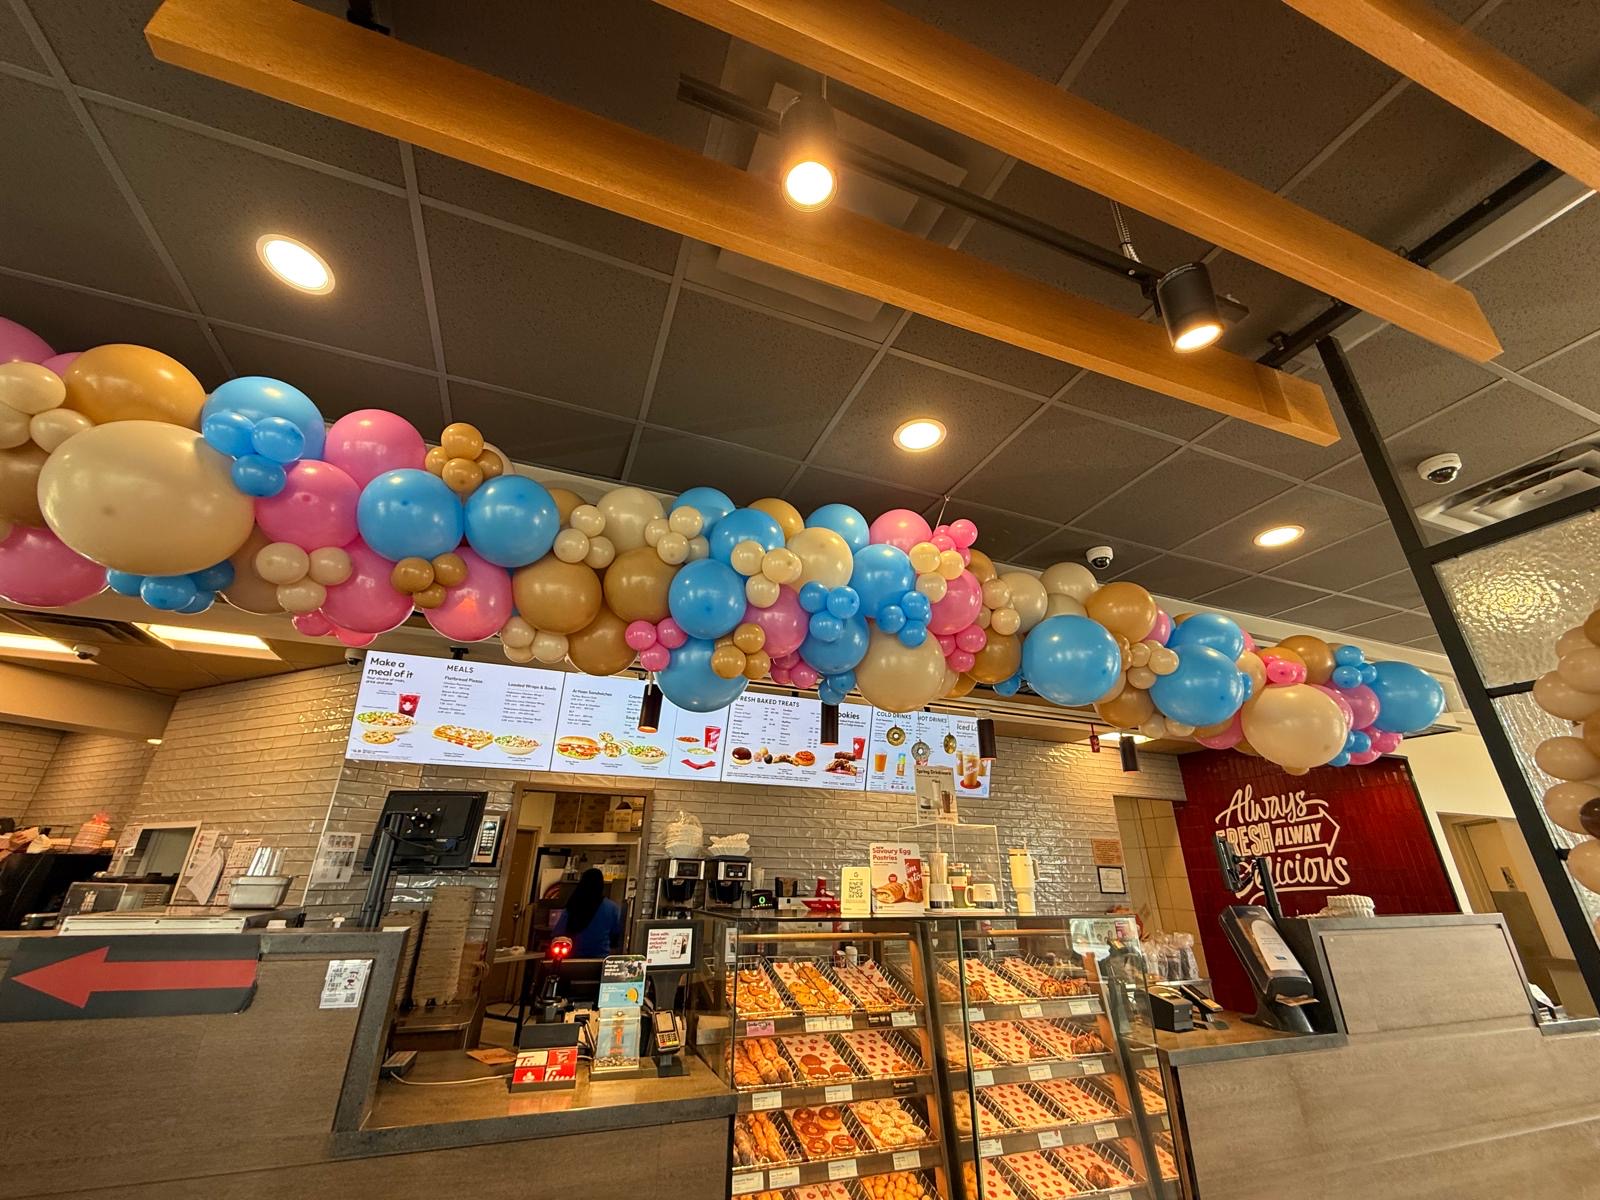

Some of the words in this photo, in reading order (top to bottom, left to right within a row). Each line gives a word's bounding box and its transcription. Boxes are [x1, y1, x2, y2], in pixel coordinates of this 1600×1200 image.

[370, 657, 397, 667] Make
[368, 669, 392, 677] meal
[393, 670, 406, 678] of
[406, 670, 414, 679] it
[446, 664, 474, 674] MEALS
[740, 695, 756, 703] RESH
[756, 697, 777, 706] BAKED
[778, 699, 800, 708] TREATS
[837, 711, 860, 720] ookies
[892, 712, 912, 720] DRINKS
[956, 723, 970, 731] Iced
[1215, 783, 1329, 827] Always
[1274, 822, 1322, 847] ALWAY
[872, 847, 898, 856] Savoury
[898, 847, 912, 856] Egg
